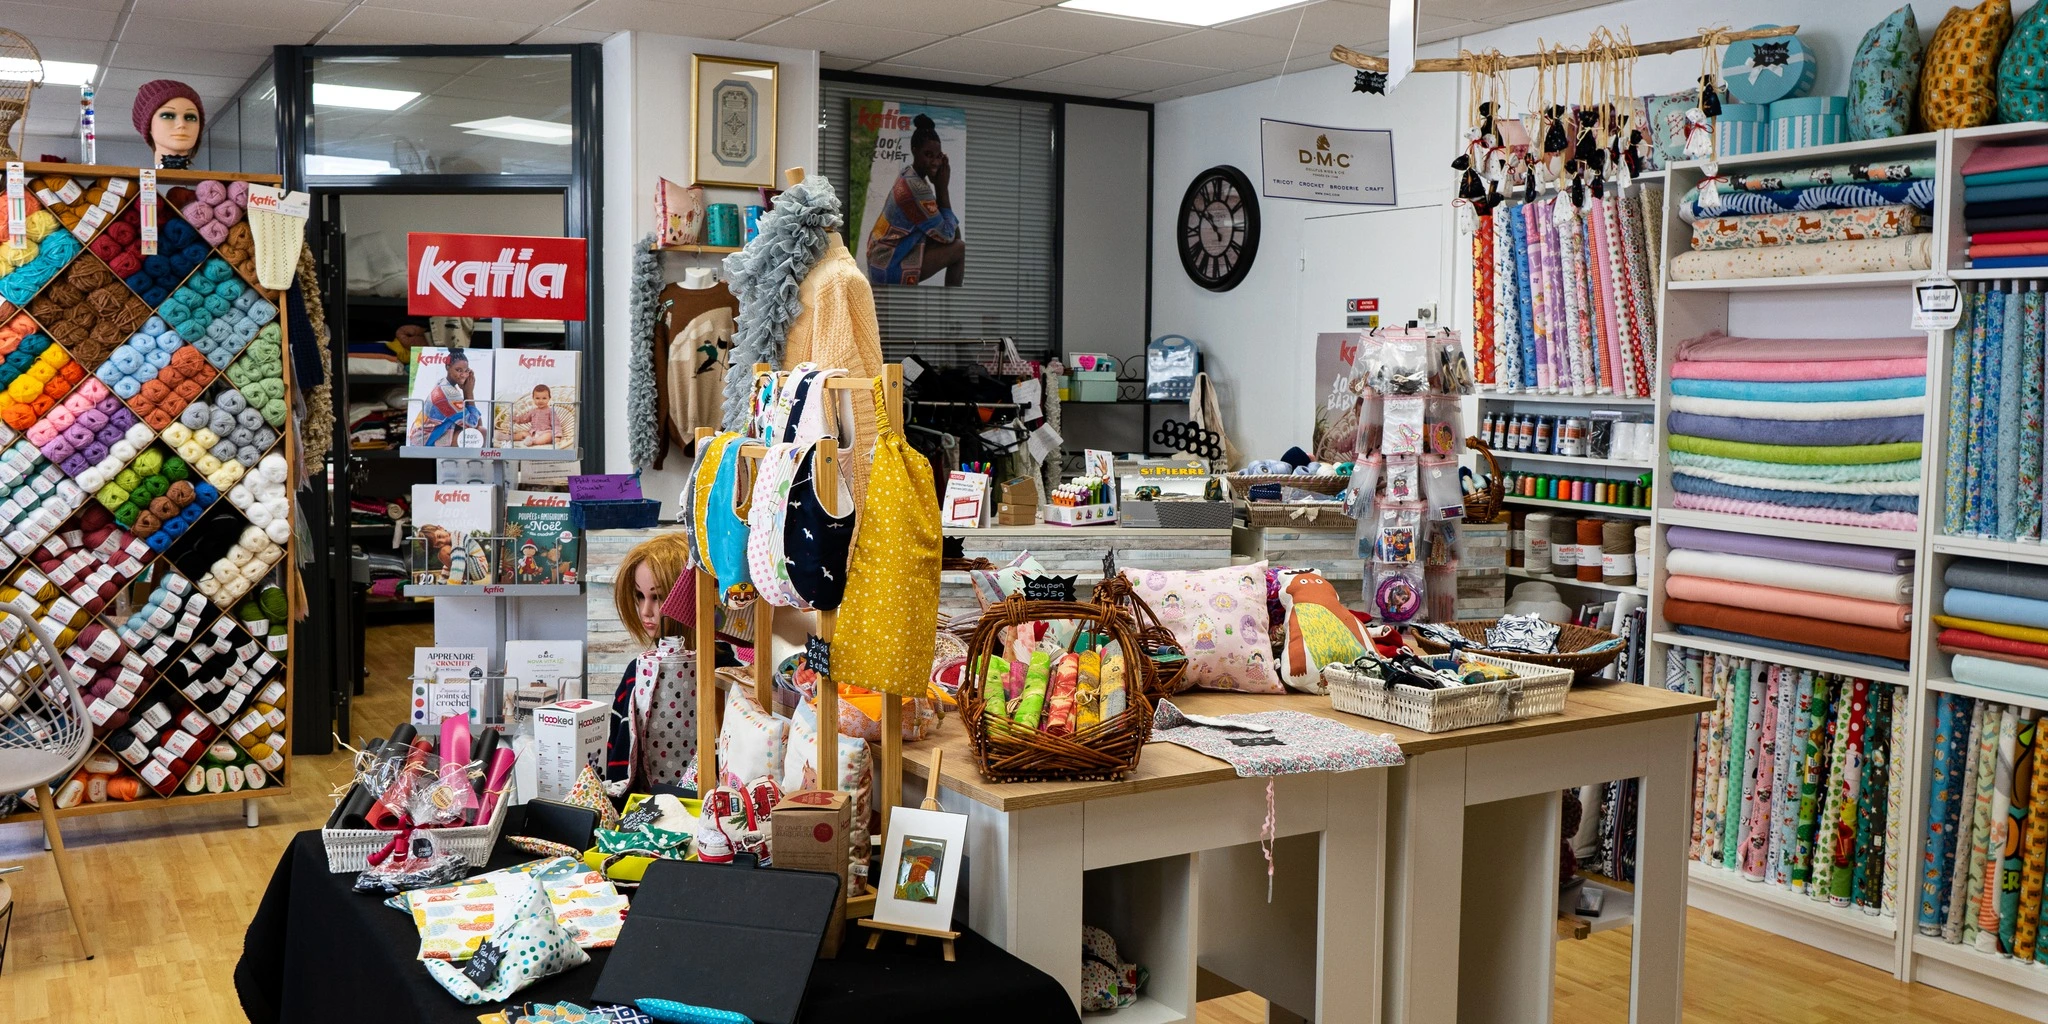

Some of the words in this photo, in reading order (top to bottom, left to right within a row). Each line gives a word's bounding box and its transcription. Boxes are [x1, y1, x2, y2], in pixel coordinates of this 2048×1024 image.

[858, 106, 911, 132] katia
[416, 245, 567, 309] katia
[417, 352, 451, 366] katia
[519, 354, 555, 369] katia
[480, 450, 501, 458] katia
[1156, 466, 1205, 475] PIERRE
[434, 490, 470, 504] katia
[525, 495, 567, 507] katia
[530, 521, 563, 531] Noël
[483, 586, 505, 595] katia
[1028, 581, 1065, 593] Coupon
[427, 652, 476, 660] APPRENDRE
[461, 692, 470, 700] de
[436, 699, 470, 707] crochet
[538, 713, 574, 726] Hoooked
[578, 713, 606, 729] Hoooked
